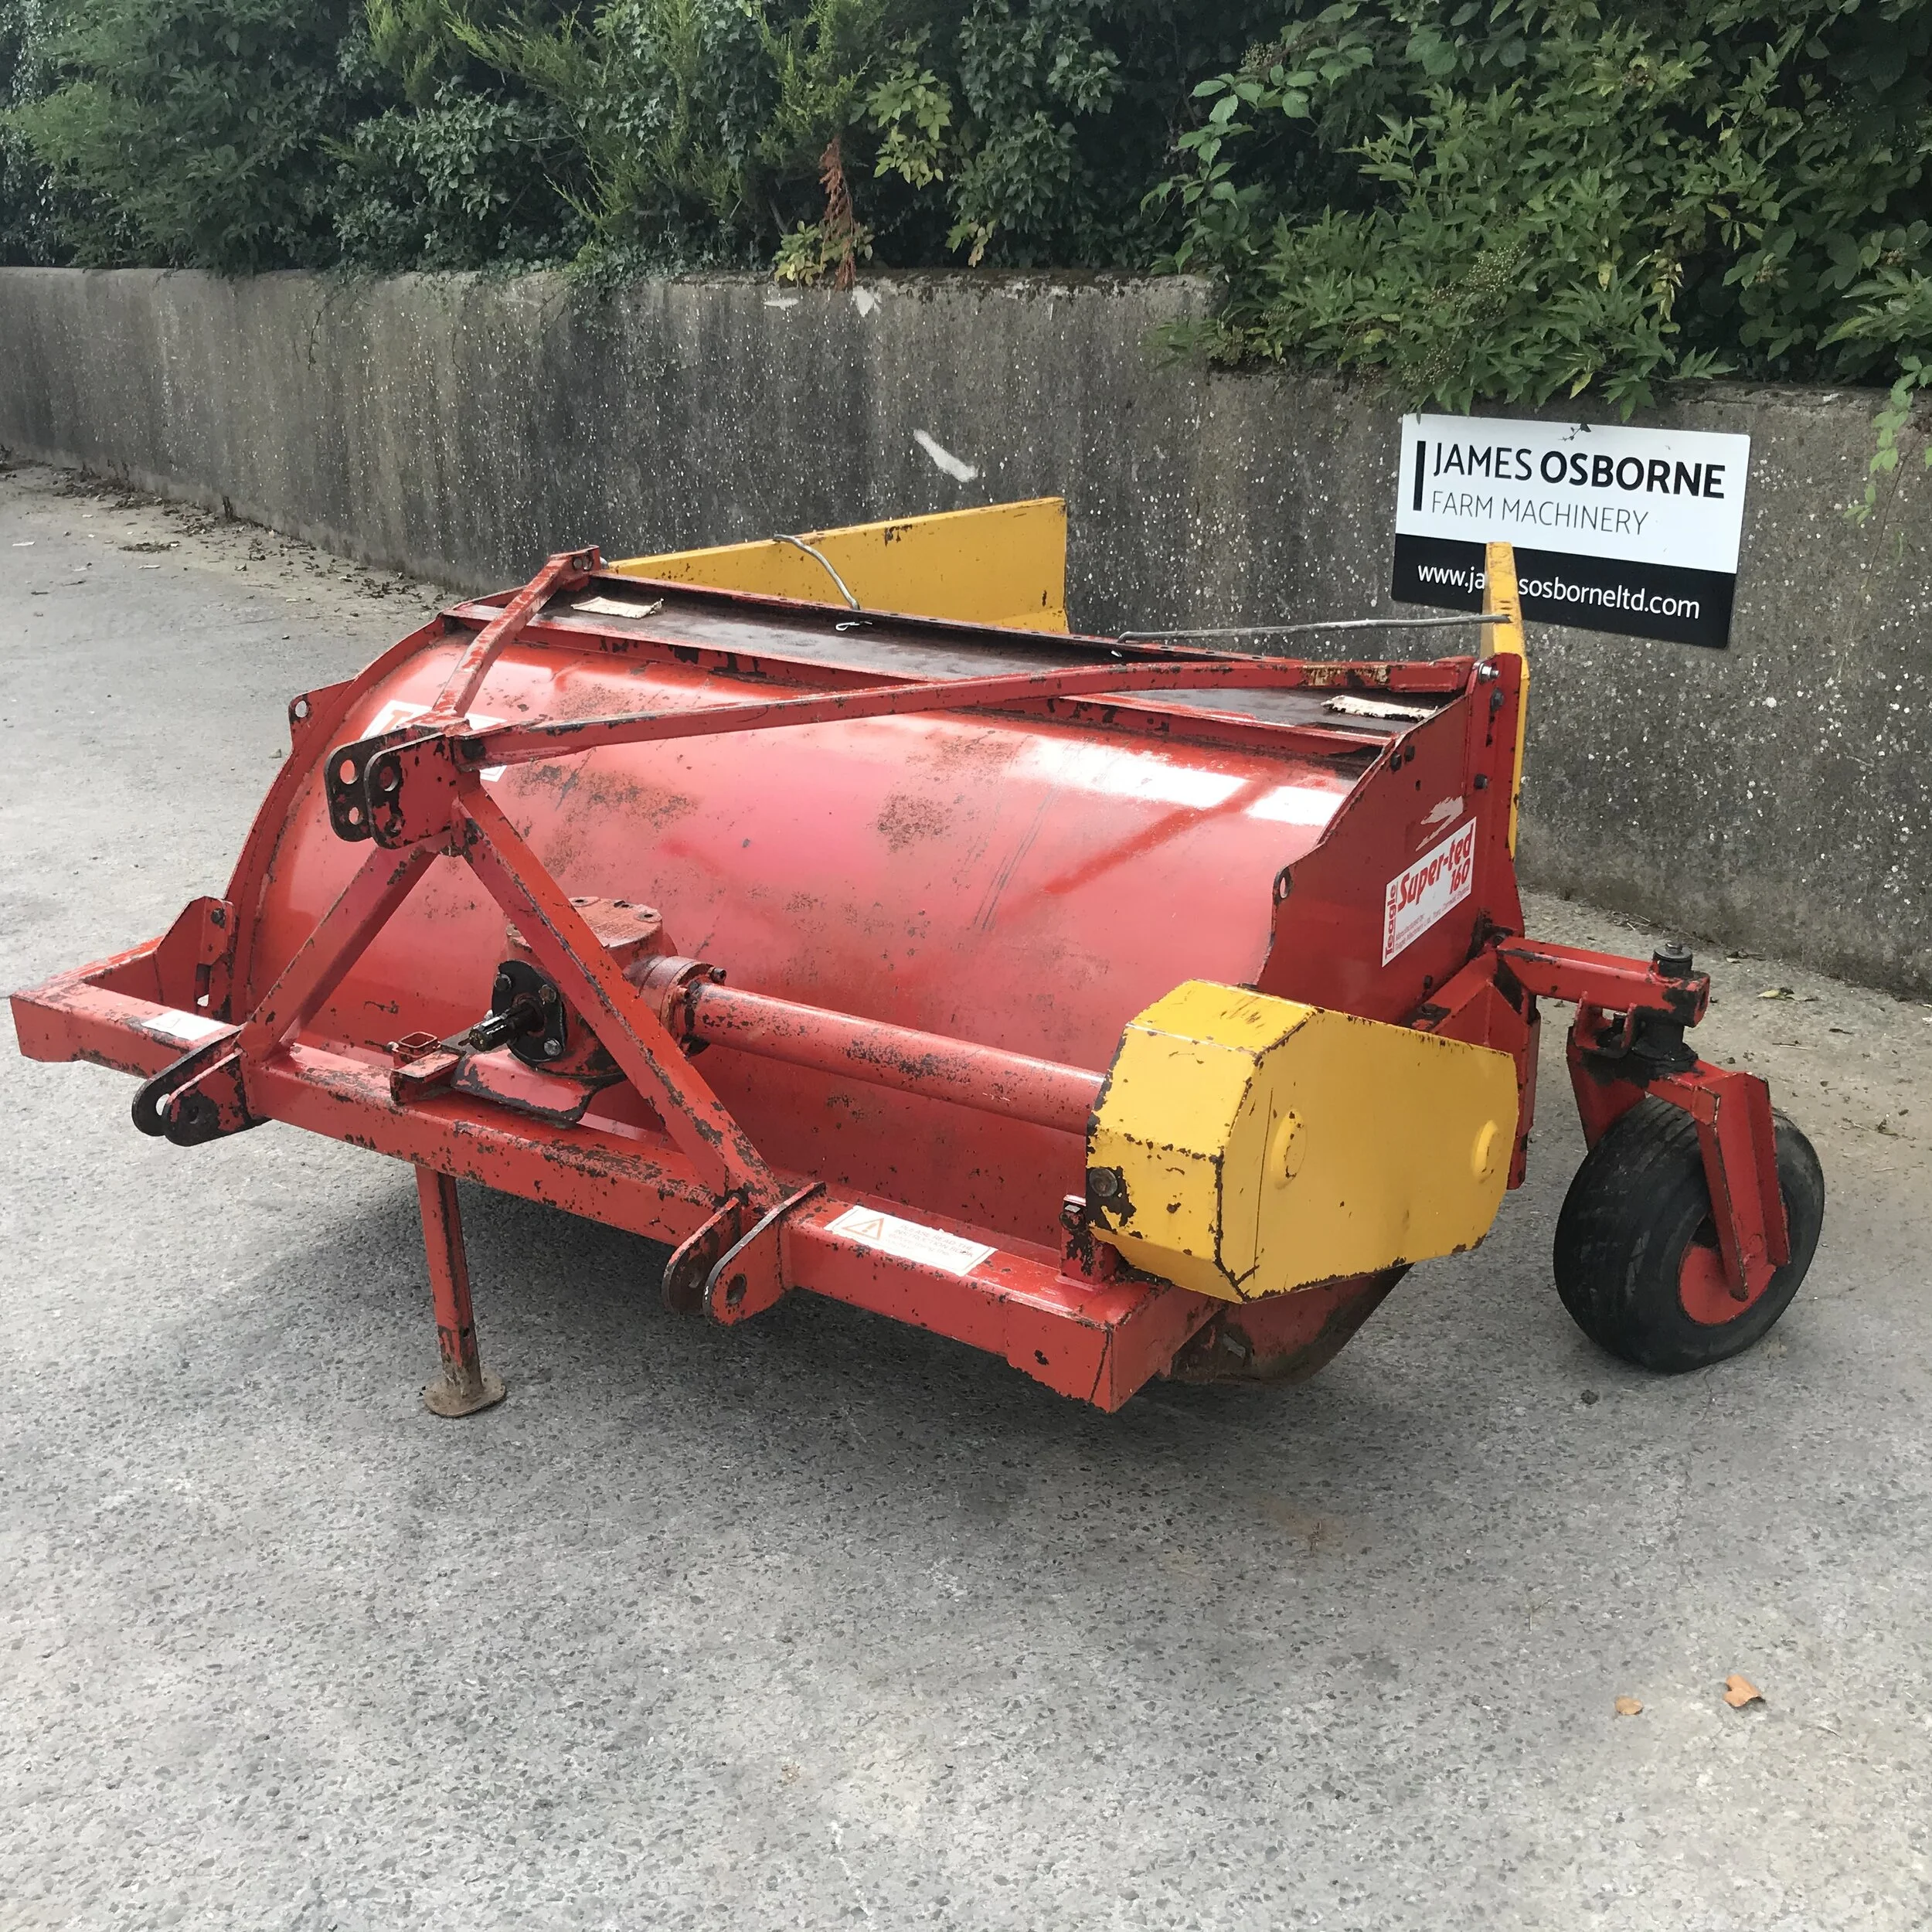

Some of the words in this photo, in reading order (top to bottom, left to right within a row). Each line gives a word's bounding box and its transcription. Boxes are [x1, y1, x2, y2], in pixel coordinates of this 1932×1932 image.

[1434, 442, 1532, 481] JAMES
[1540, 451, 1726, 499] OSBORNE
[1431, 490, 1493, 519] FARM
[1502, 498, 1649, 536] MACHINERY
[1417, 564, 1700, 619] www.jasosborneltd.com
[1397, 822, 1475, 913] Super-ted
[1449, 858, 1471, 894] 160
[1385, 883, 1396, 959] Teagle
